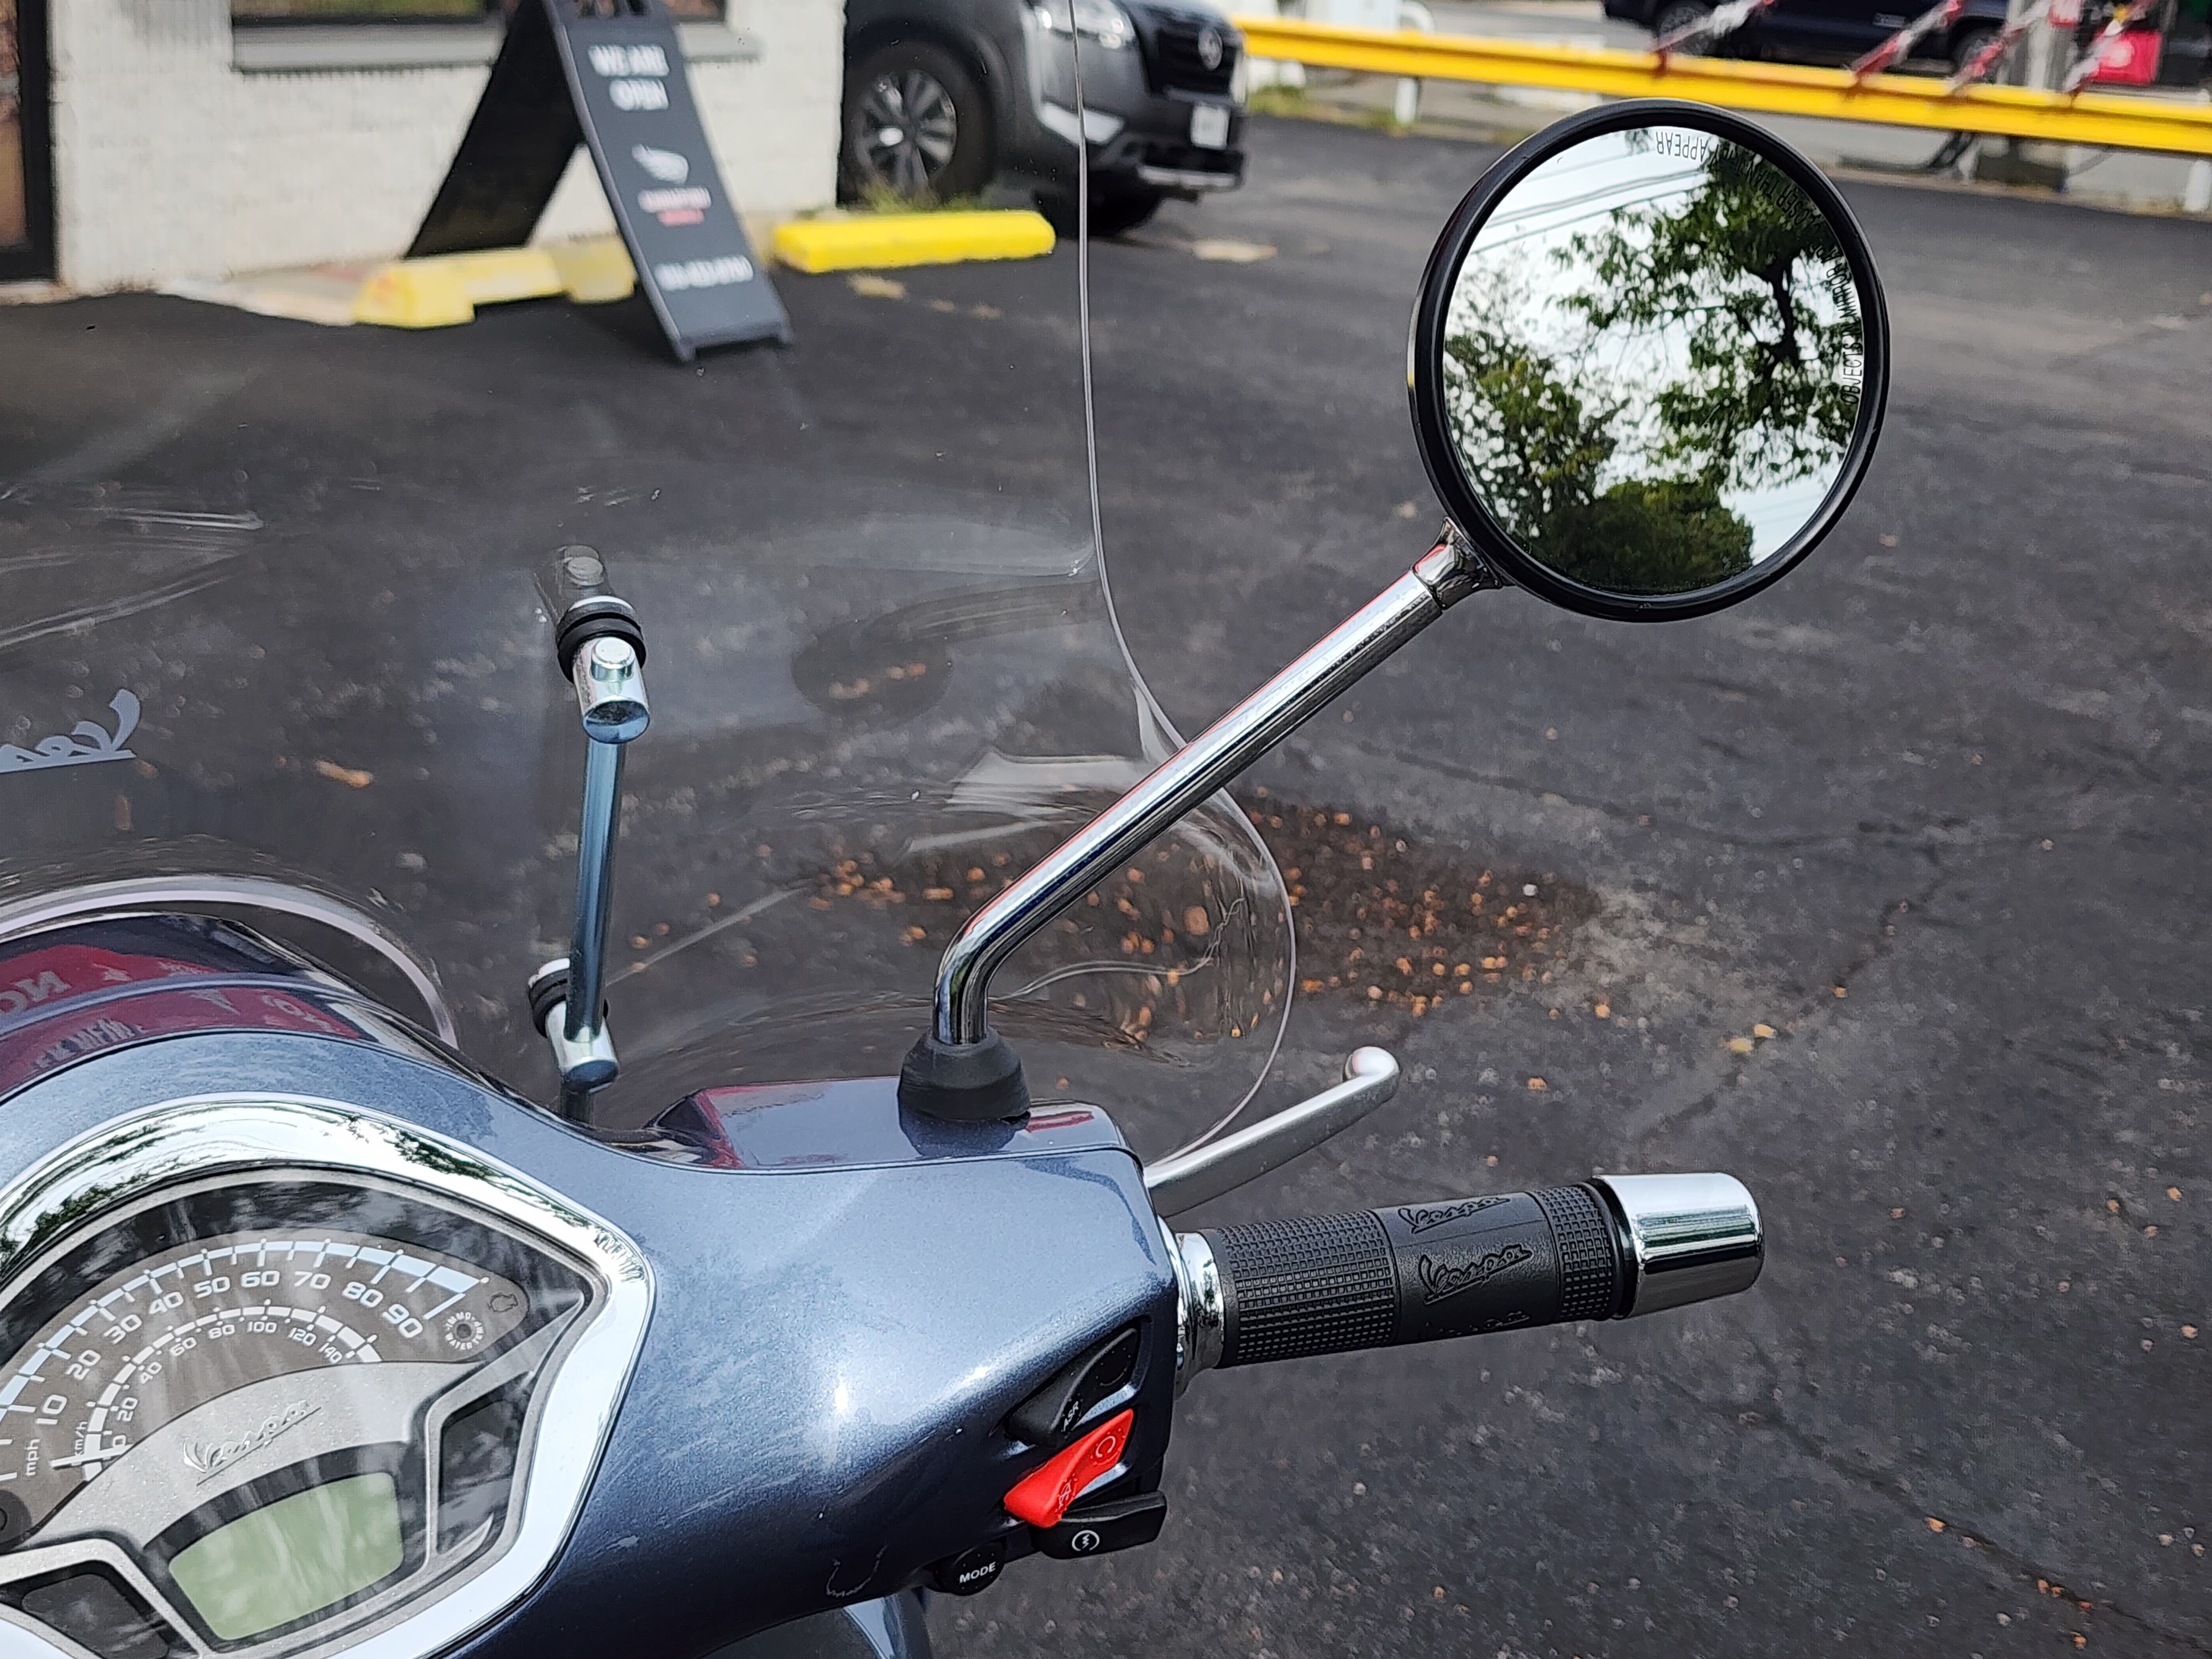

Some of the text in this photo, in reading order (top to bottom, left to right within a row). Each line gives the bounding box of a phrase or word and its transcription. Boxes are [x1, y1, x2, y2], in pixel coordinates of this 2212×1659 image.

[1656, 131, 1709, 162] APPEAR
[1840, 342, 1863, 405] OBJECTS
[1418, 1244, 1532, 1305] Vespa
[35, 1270, 423, 1425] 10 20 30 40 50 60 70 80 90
[117, 1397, 138, 1422] 20
[140, 1361, 163, 1384] 40
[170, 1337, 197, 1357] 60
[208, 1324, 236, 1339] 80
[247, 1321, 277, 1334] 100
[287, 1327, 317, 1347] 120
[318, 1342, 343, 1364] 140
[183, 1400, 320, 1484] Vespa
[1063, 1401, 1079, 1432] ASR
[25, 1439, 40, 1476] mph
[959, 1561, 996, 1583] MODE
